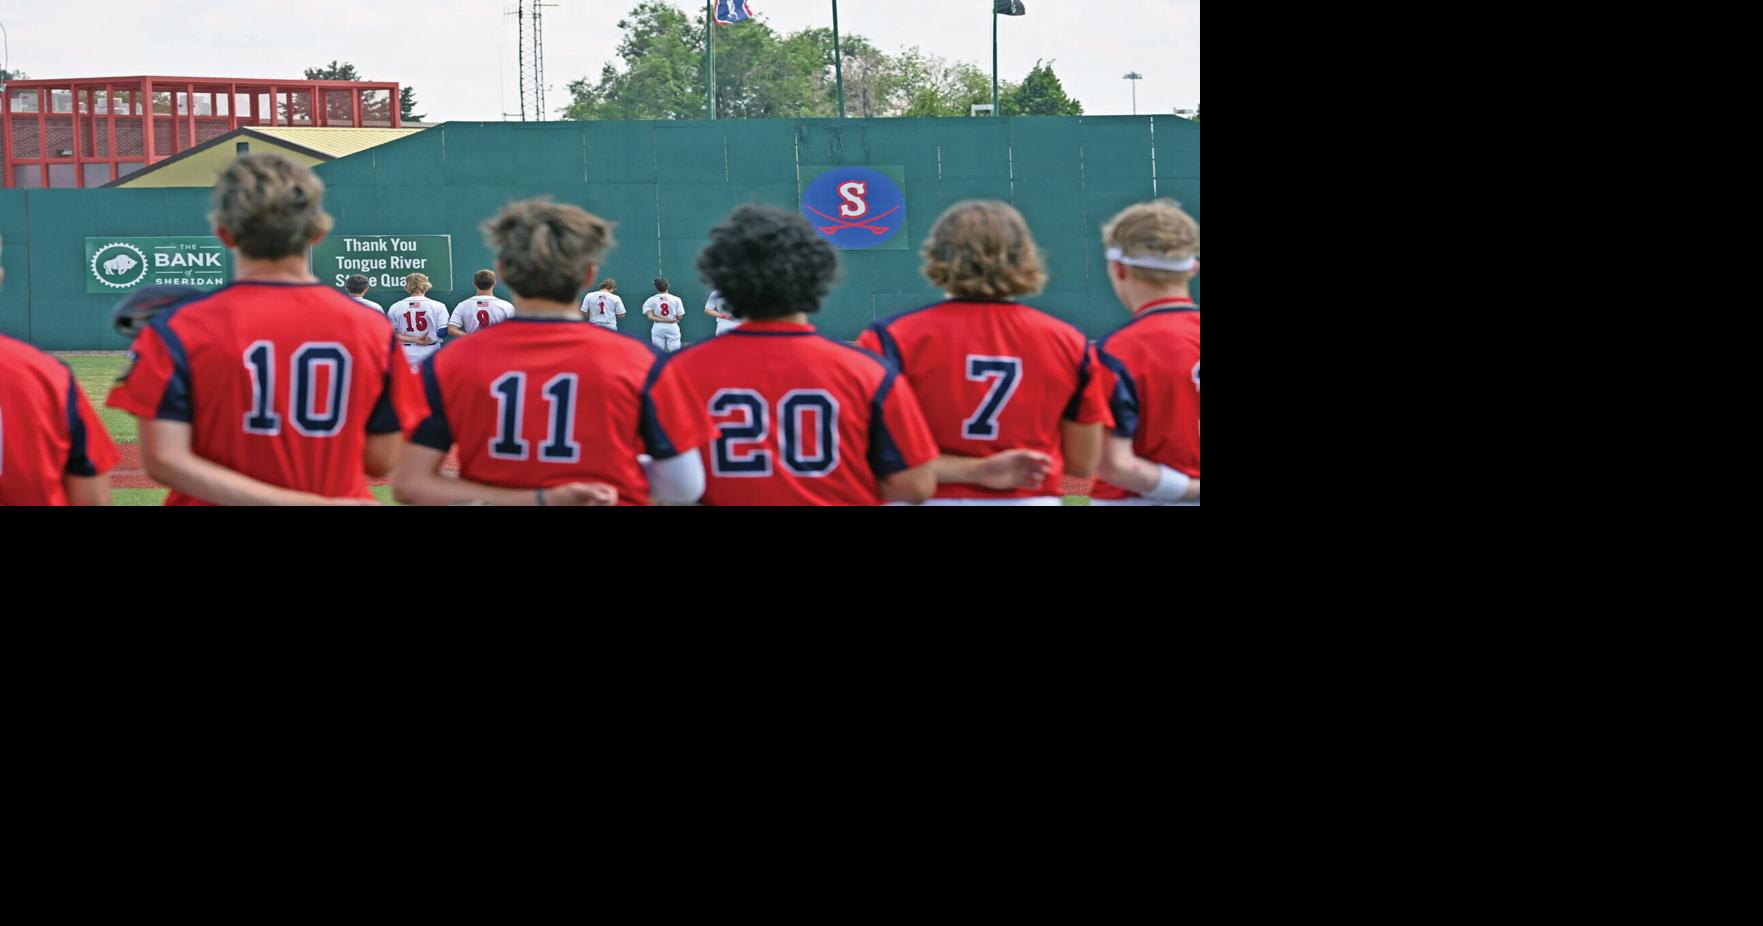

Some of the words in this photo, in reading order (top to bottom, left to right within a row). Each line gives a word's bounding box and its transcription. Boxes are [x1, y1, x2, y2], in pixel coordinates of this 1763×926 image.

[837, 179, 869, 219] S
[343, 238, 388, 252] Thank
[390, 238, 417, 252] You
[154, 252, 222, 267] BANK
[335, 256, 387, 273] Tongue
[390, 256, 427, 269] River
[155, 277, 223, 285] SHERIDAN
[184, 269, 192, 277] of
[598, 301, 605, 315] 1
[660, 302, 670, 316] 8
[403, 310, 428, 332] 15
[242, 339, 352, 438] 10
[961, 354, 1023, 441] 7
[488, 371, 581, 464] 11
[708, 388, 840, 477] 20
